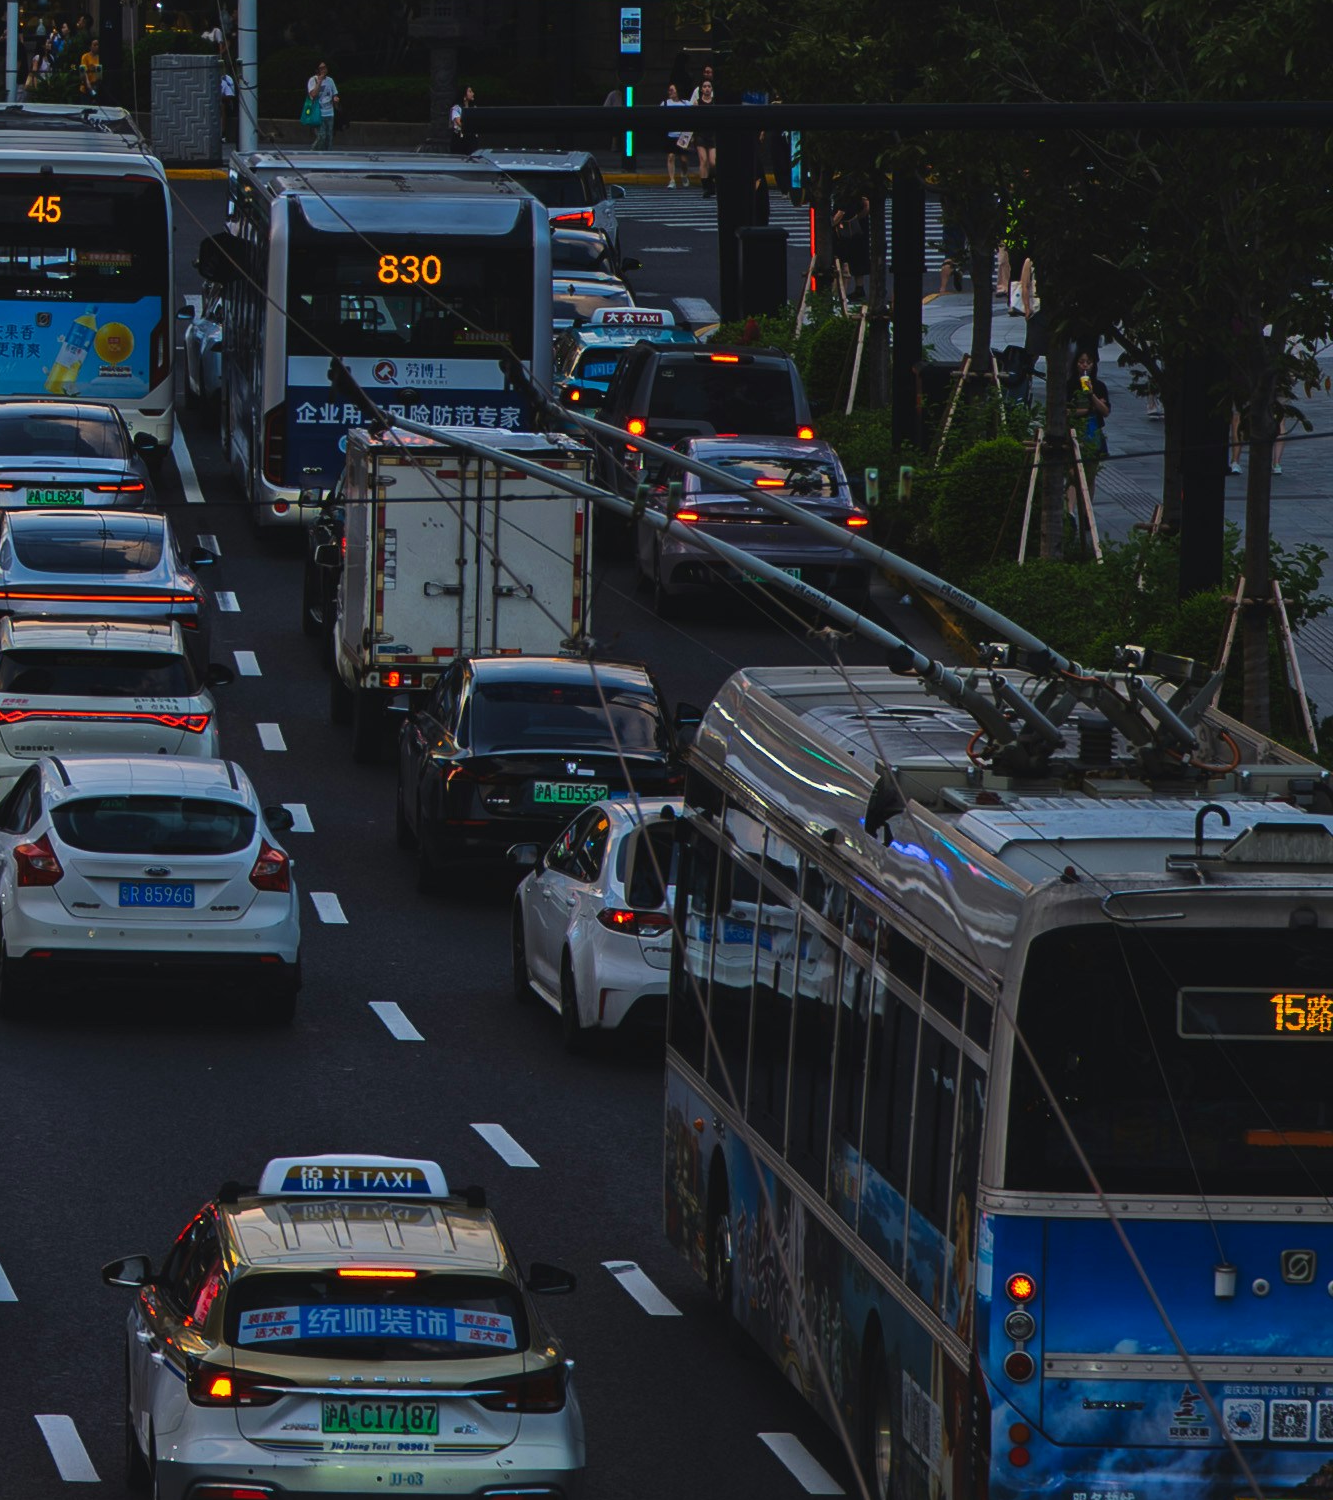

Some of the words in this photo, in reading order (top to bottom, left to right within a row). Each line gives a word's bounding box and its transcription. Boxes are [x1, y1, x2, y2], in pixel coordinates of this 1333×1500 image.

[28, 195, 61, 223] 45
[378, 254, 441, 284] 830
[606, 312, 635, 324] 大众
[636, 312, 662, 324] TAXI
[406, 362, 448, 378] 劳博士
[296, 401, 522, 428] 企业用风险防范专家
[300, 1167, 355, 1191] 锦江
[358, 1171, 413, 1189] TAXI
[306, 1307, 450, 1339] 统帅装饰
[397, 1442, 430, 1452] 96961
[390, 1472, 424, 1487] JJ-03
